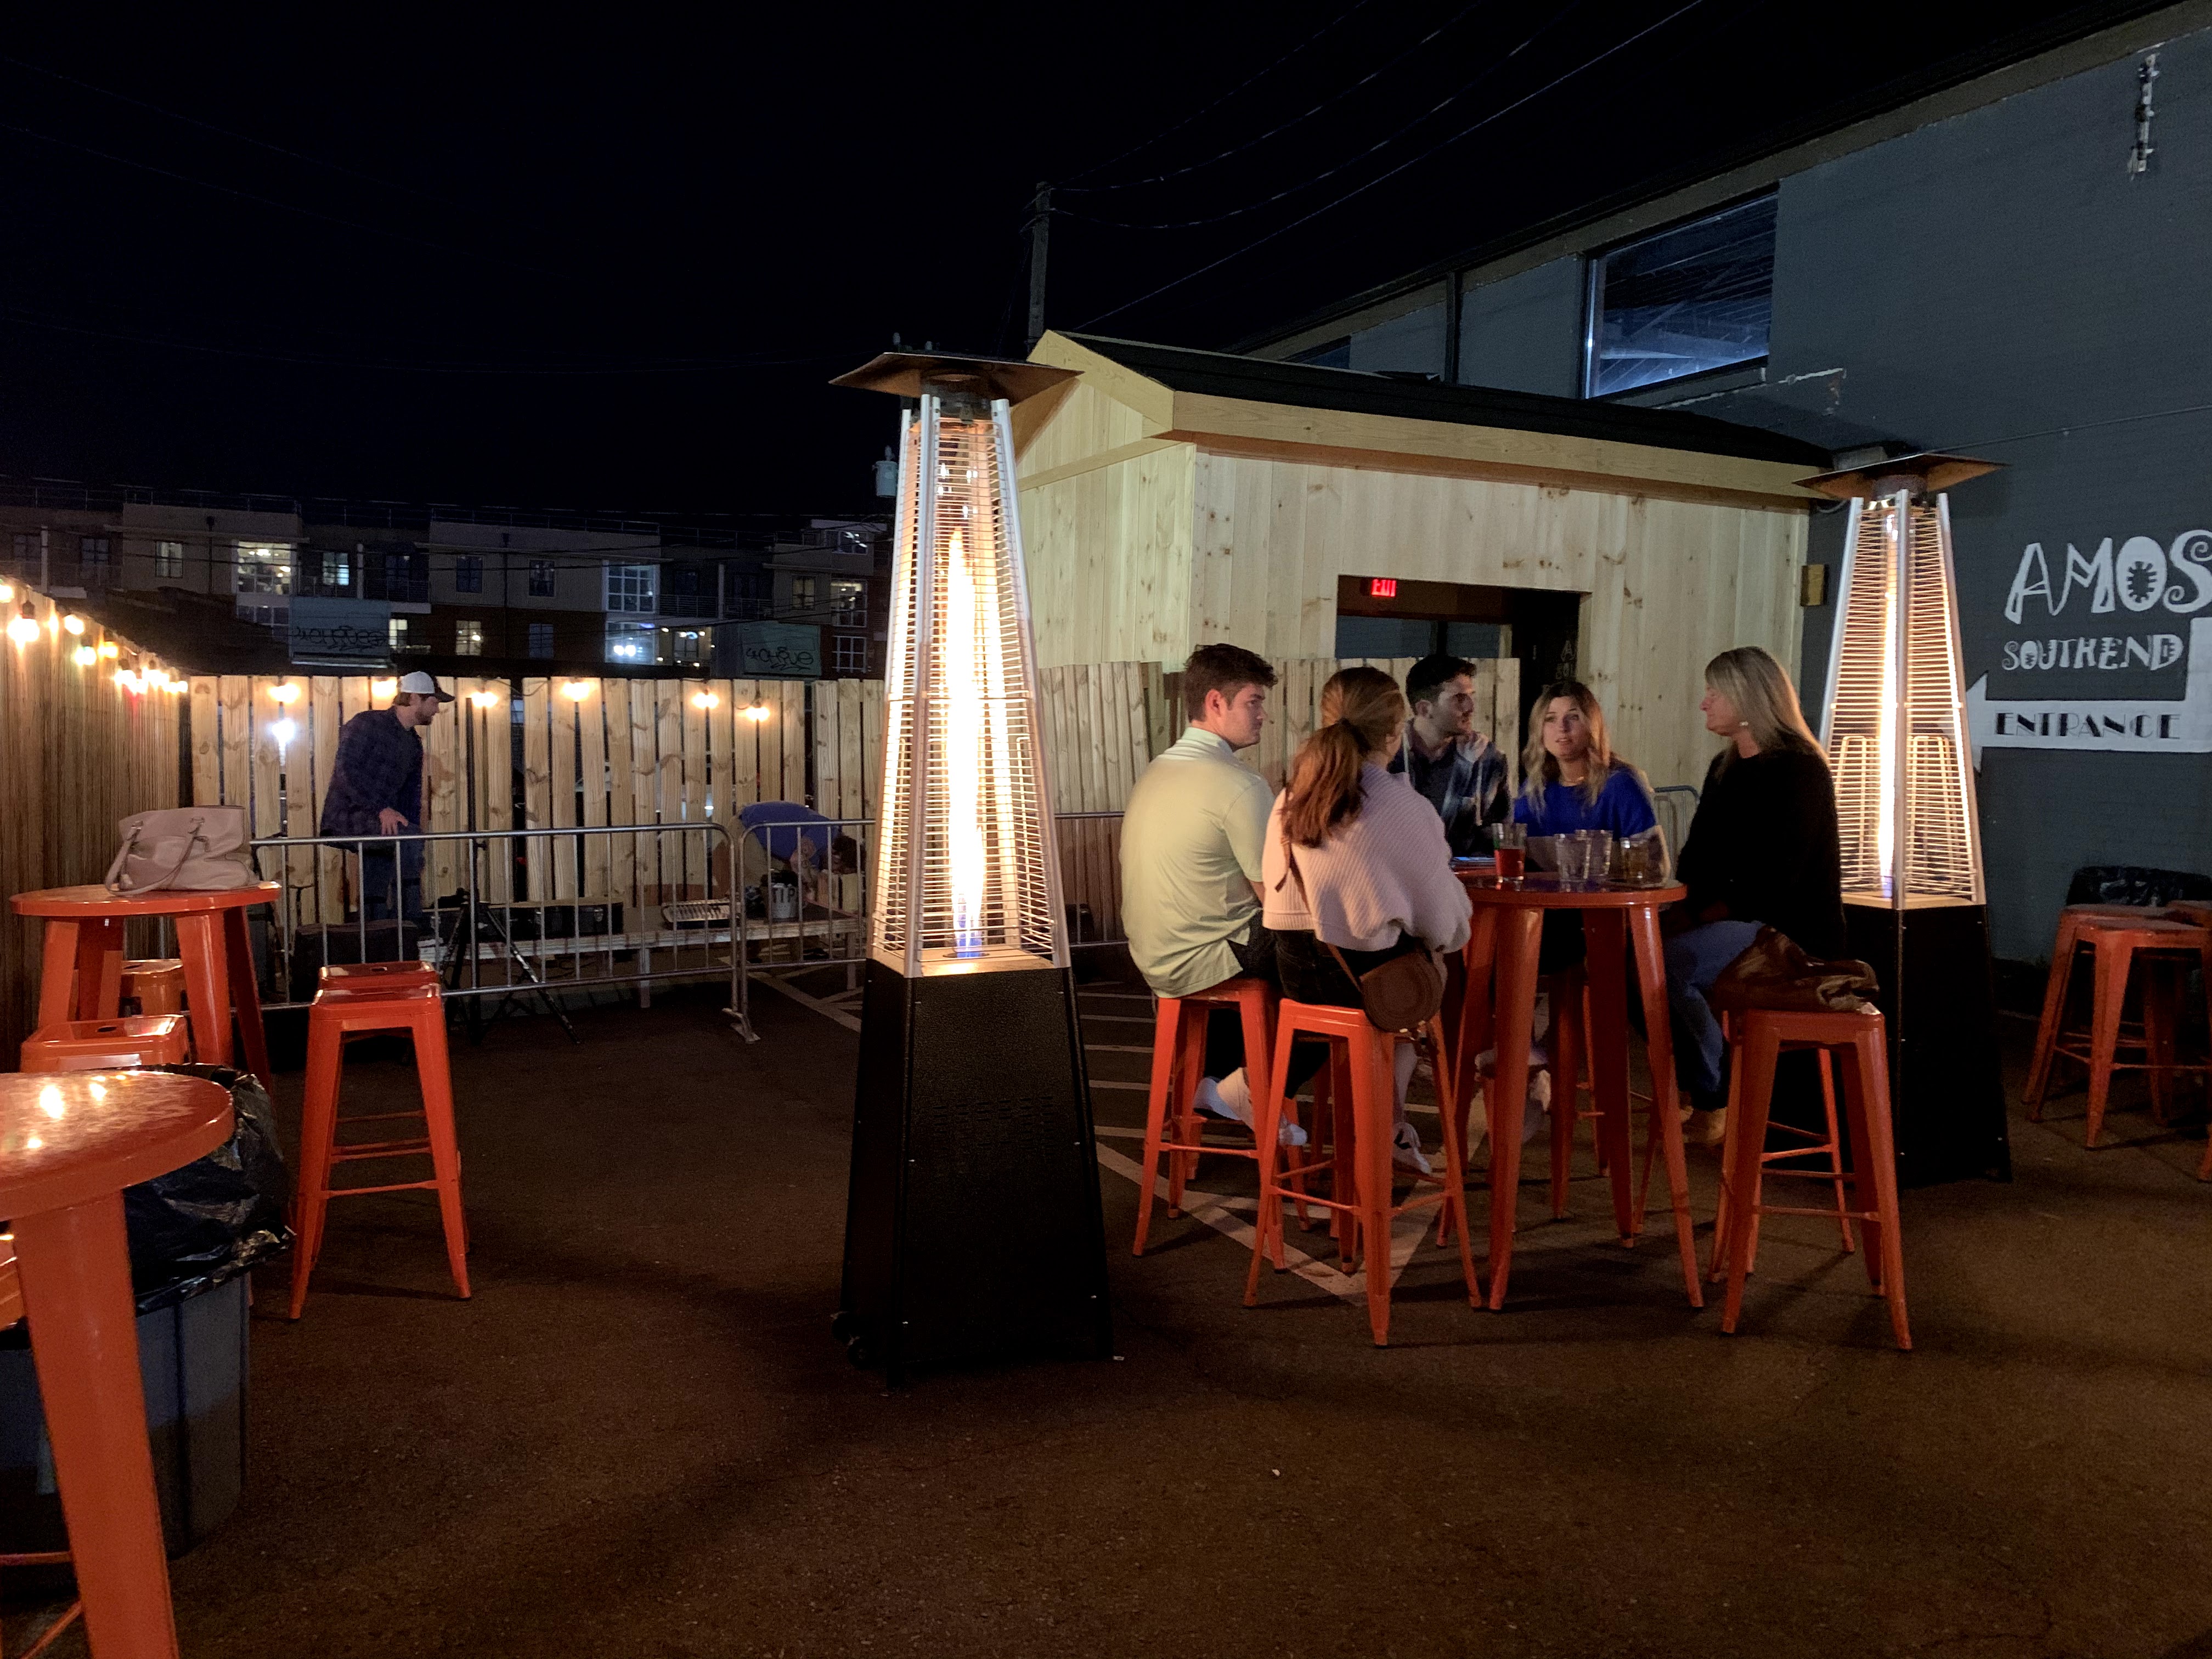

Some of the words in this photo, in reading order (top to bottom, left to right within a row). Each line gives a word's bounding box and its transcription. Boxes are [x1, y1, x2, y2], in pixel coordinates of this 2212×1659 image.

[2004, 529, 2212, 624] AMOS
[2001, 634, 2183, 670] SOUTHEND
[1995, 712, 2181, 740] ENTRANCE
